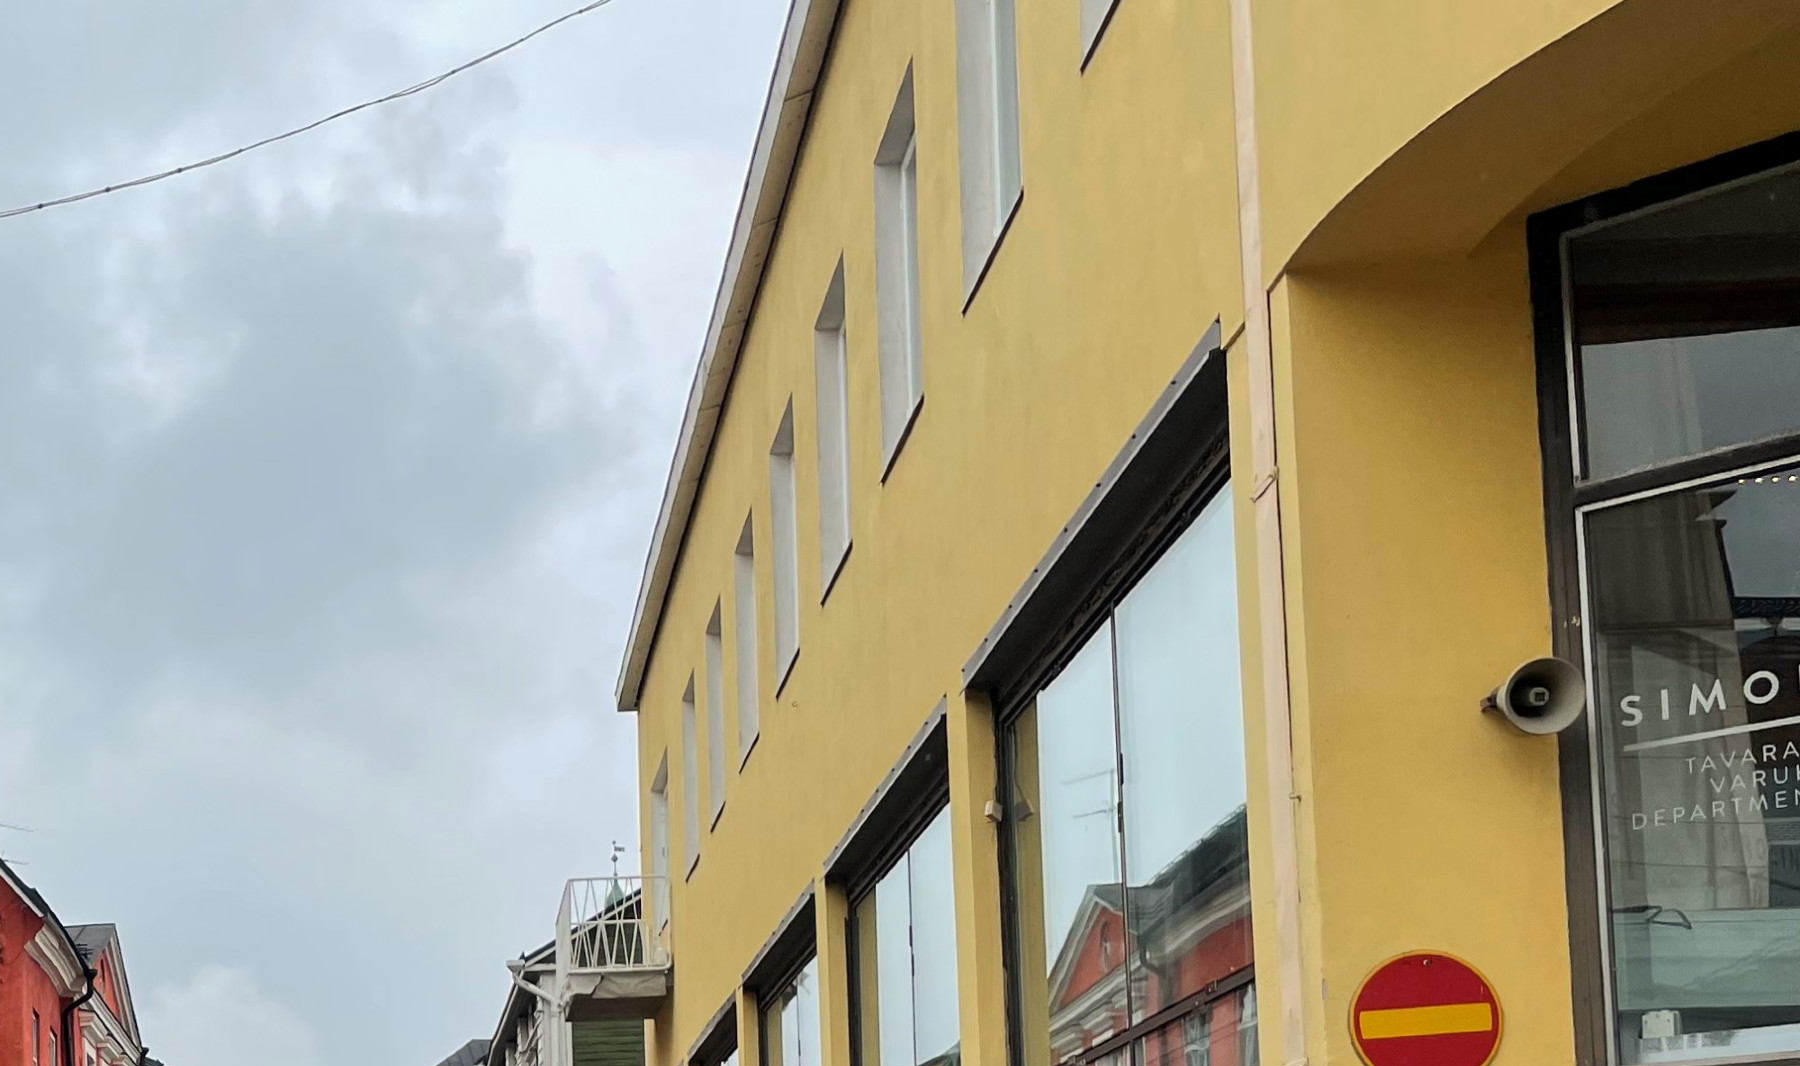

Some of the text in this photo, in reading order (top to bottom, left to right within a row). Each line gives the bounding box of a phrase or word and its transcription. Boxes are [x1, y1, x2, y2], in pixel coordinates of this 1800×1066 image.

[1620, 664, 1800, 727] SIMO
[1685, 741, 1800, 774] TAVARA
[1709, 764, 1800, 793] VARU
